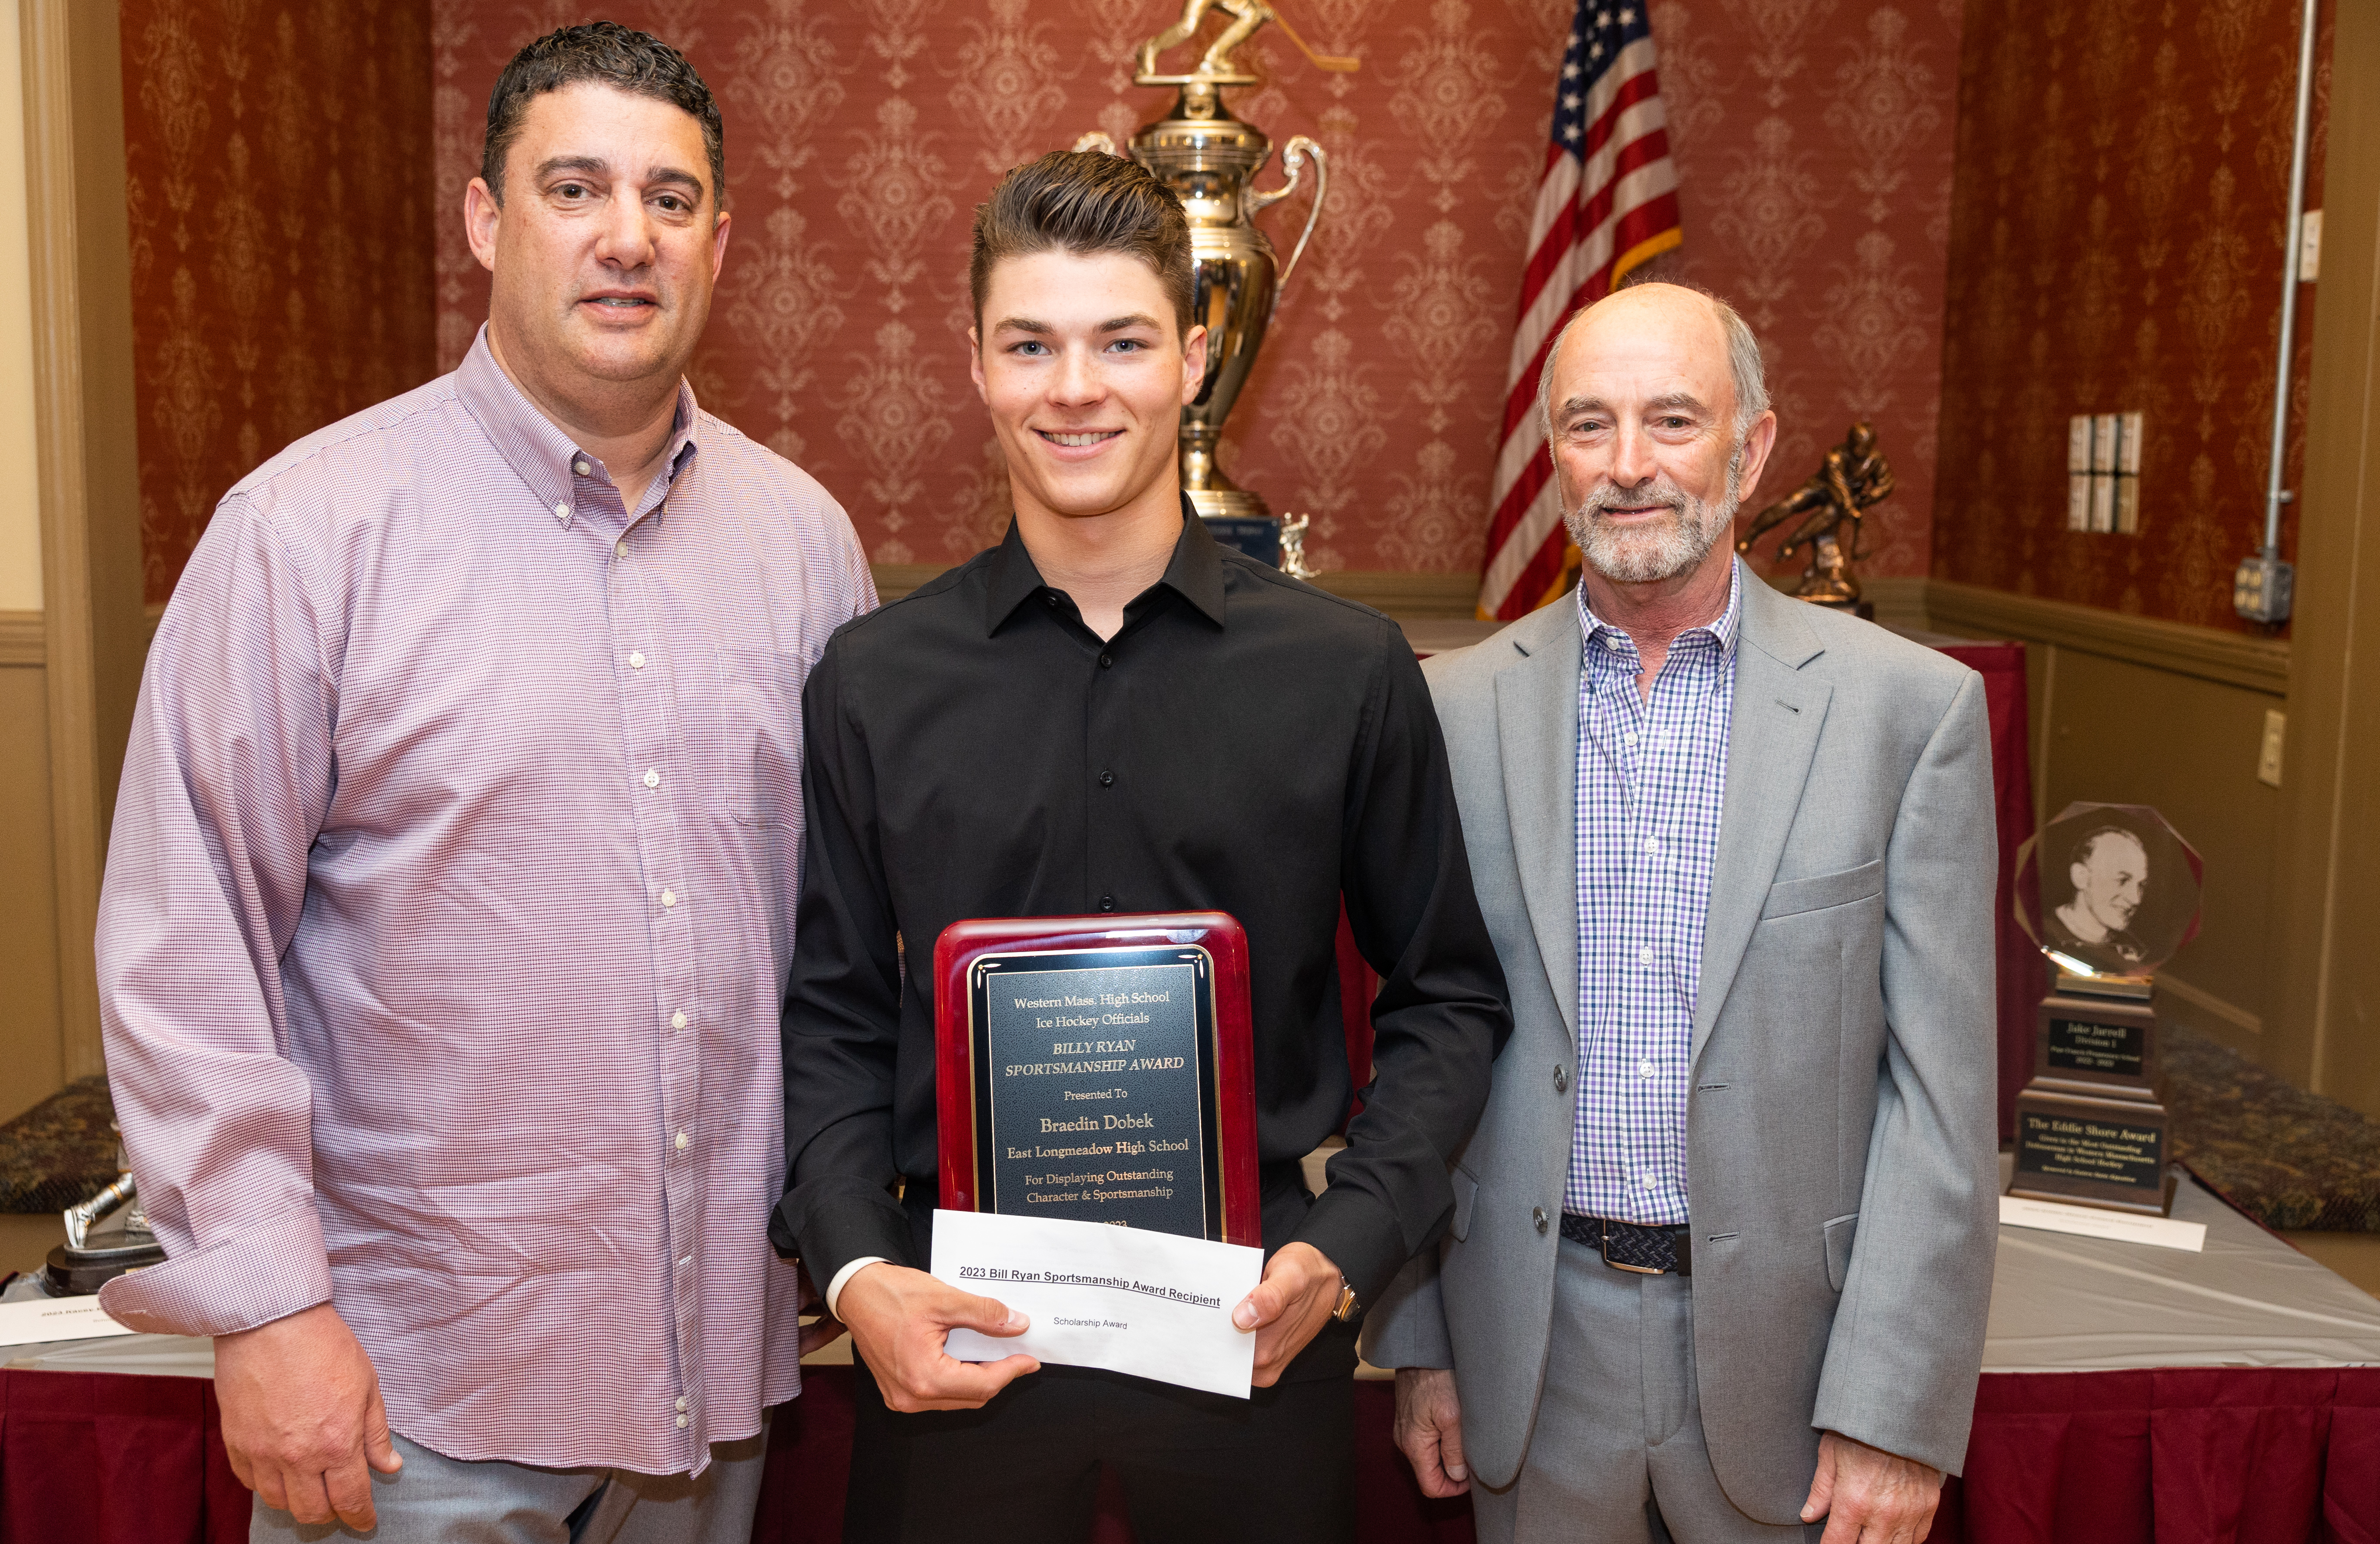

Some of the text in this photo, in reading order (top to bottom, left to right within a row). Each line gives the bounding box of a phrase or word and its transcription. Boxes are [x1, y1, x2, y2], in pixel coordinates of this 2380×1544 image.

[1014, 991, 1169, 1009] Western Mass. High School
[1036, 1012, 1149, 1029] Ice Hockey Officials
[1053, 1040, 1136, 1055] BILLY RYAN
[1005, 1057, 1184, 1076] SPORTSMANSHIP AWARD
[1064, 1089, 1128, 1100] Presented To
[1040, 1113, 1154, 1133] Braedin Dobek
[2028, 1117, 2155, 1143] The Eddie Shore Award
[1007, 1138, 1188, 1159] East Longmeadow High School
[1025, 1169, 1174, 1186] For Displaying Outstanding
[1027, 1186, 1173, 1203] Character & Sportsmanship
[960, 1267, 1220, 1306] 2023 Bill Ryan Sportsmanship Award Recipient
[1054, 1317, 1127, 1329] Scholarship Award
